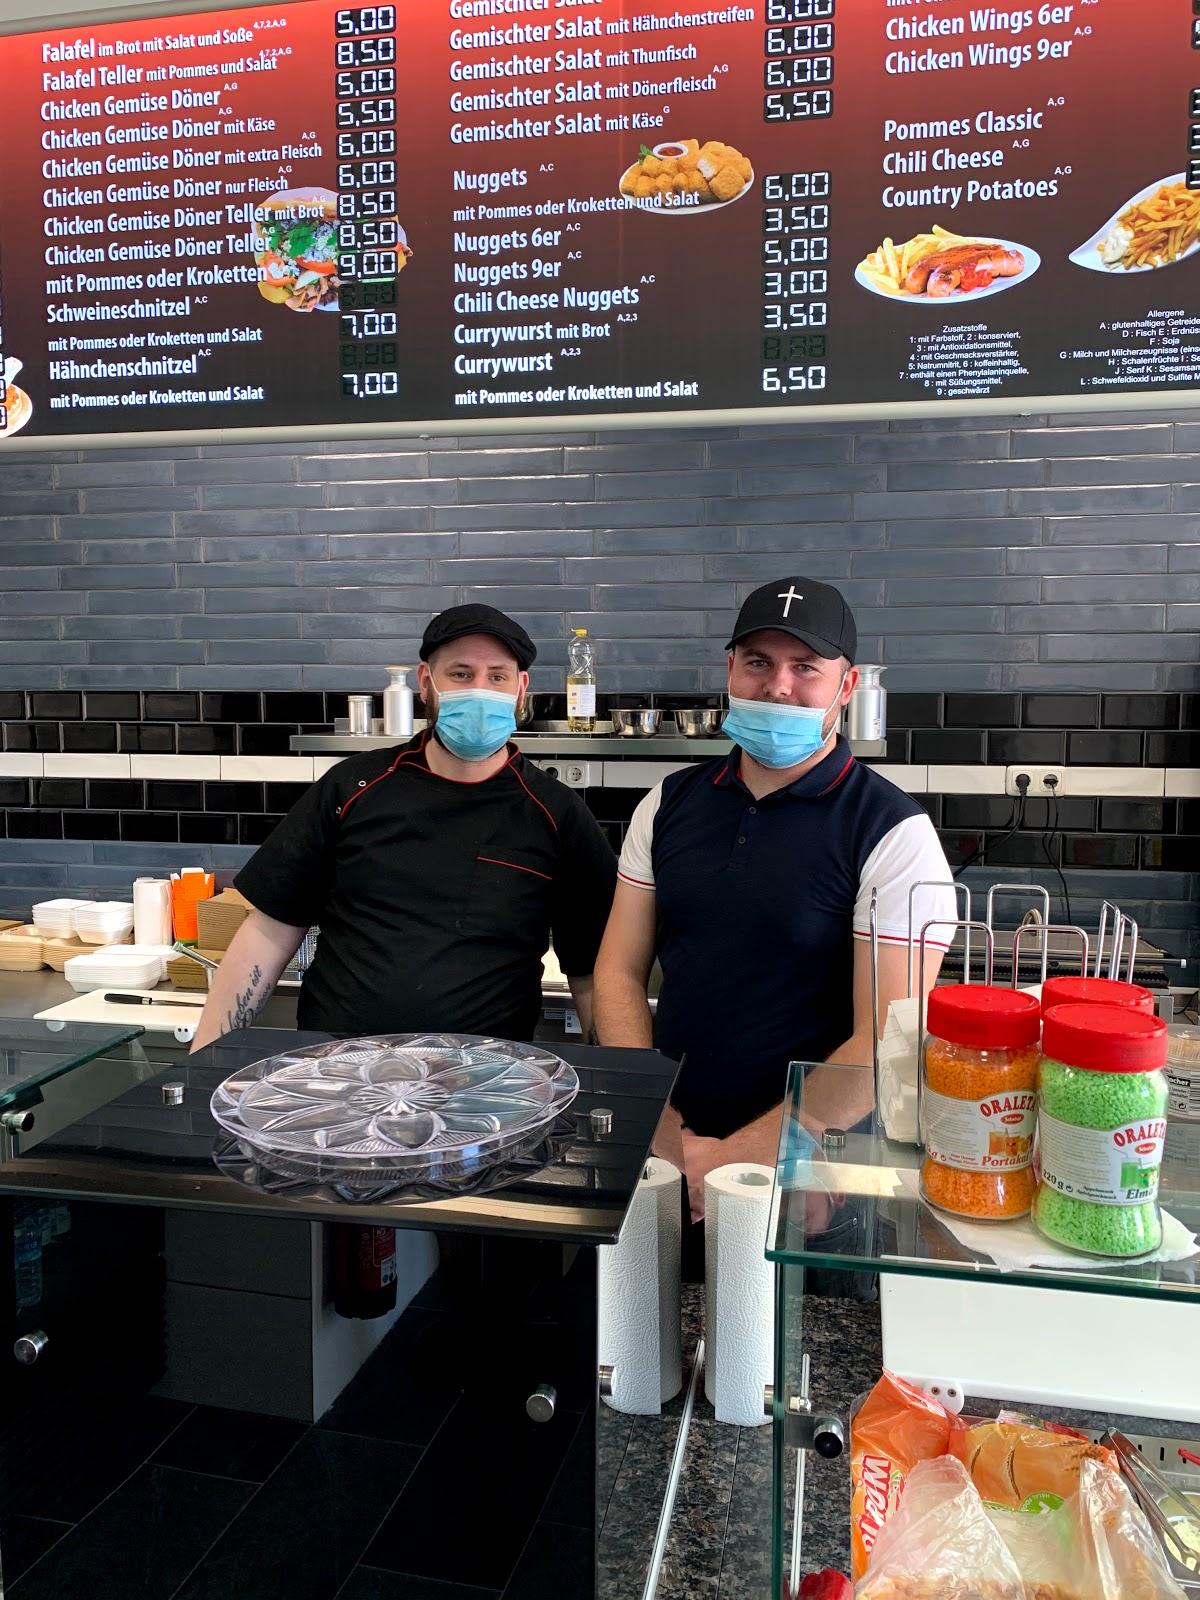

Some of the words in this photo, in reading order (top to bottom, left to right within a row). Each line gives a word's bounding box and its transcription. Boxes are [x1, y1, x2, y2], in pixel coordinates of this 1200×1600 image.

[450, 22, 551, 50] Gemischter
[555, 16, 602, 39] Salat
[606, 19, 629, 35] mit
[632, 7, 754, 32] Hähnchenstreifen
[886, 14, 964, 40] Chicken
[969, 8, 1032, 34] Wings
[1038, 4, 1073, 25] 6er
[42, 39, 95, 63] Falafel
[99, 44, 113, 56] im
[116, 40, 140, 55] Brot
[143, 36, 163, 52] mit
[165, 33, 195, 50] Salat
[198, 30, 220, 46] und
[223, 28, 253, 44] Soße
[885, 49, 963, 74] Chicken
[968, 42, 1031, 68] Wings
[1037, 38, 1072, 59] 9er
[43, 67, 95, 91] Falafel
[99, 62, 143, 86] Teller
[146, 66, 166, 82] mit
[169, 61, 218, 79] Pommes
[221, 58, 243, 74] und
[246, 55, 277, 71] Salat
[41, 97, 100, 122] Chicken
[104, 90, 167, 115] Gemüse
[172, 87, 220, 110] Döner
[450, 85, 550, 113] Gemischter
[554, 80, 602, 101] Salat
[606, 84, 629, 99] mit
[632, 75, 716, 96] Dönerfleisch
[42, 127, 101, 151] Chicken
[105, 120, 167, 144] Gemüse
[172, 117, 221, 139] Döner
[224, 120, 245, 134] mit
[248, 117, 275, 132] Käse
[450, 116, 550, 144] Gemischter
[554, 112, 601, 135] Salat
[606, 116, 629, 131] mit
[632, 113, 663, 128] Käse
[884, 118, 970, 141] Pommes
[975, 107, 1043, 134] Classic
[42, 156, 101, 180] Chicken
[106, 150, 168, 174] Gemüse
[173, 147, 221, 169] Döner
[224, 150, 245, 165] mit
[248, 148, 279, 163] extra
[281, 143, 322, 160] Fleisch
[883, 151, 927, 174] Chili
[932, 148, 1003, 170] Cheese
[43, 186, 102, 209] Chicken
[106, 180, 169, 203] Gemüse
[174, 176, 222, 199] Döner
[225, 182, 246, 194] nur
[248, 177, 288, 192] Fleisch
[454, 168, 527, 194] Nuggets
[882, 185, 963, 209] Country
[967, 178, 1058, 202] Potatoes
[44, 214, 103, 238] Chicken
[107, 209, 170, 231] Gemüse
[174, 204, 223, 228] Döner
[225, 202, 271, 224] Teller
[275, 206, 296, 219] mit
[298, 203, 324, 217] Brot
[453, 207, 475, 221] mit
[478, 204, 532, 220] Pommes
[536, 202, 563, 216] oder
[567, 197, 633, 213] Kroketten
[637, 195, 662, 210] und
[665, 191, 699, 207] Salat
[454, 230, 527, 255] Nuggets
[531, 227, 561, 247] 6er
[46, 277, 73, 295] mit
[77, 272, 144, 293] Pommes
[147, 268, 183, 288] oder
[187, 263, 267, 286] Kroketten
[454, 260, 527, 286] Nuggets
[531, 259, 561, 279] 9er
[47, 296, 190, 323] Schweineschnitzel
[454, 291, 492, 314] Chili
[497, 288, 559, 311] Cheese
[563, 285, 639, 312] Nuggets
[1148, 310, 1184, 318] Allergene
[455, 321, 552, 347] Currywurst
[556, 325, 579, 339] mit
[583, 323, 610, 338] Brot
[943, 324, 987, 332] Zusatzstoffe
[1162, 338, 1179, 346] Soja
[49, 355, 197, 380] Hähnchenschnitzel
[455, 352, 553, 377] Currywurst
[1127, 366, 1144, 374] Senf
[50, 393, 70, 408] mit
[72, 392, 119, 408] Pommes
[121, 390, 147, 405] oder
[149, 388, 206, 404] Kroketten
[209, 388, 231, 401] und
[233, 386, 263, 400] Salat
[455, 390, 477, 405] mit
[480, 388, 533, 404] Pommes
[535, 386, 566, 402] oder
[568, 383, 633, 400] Kroketten
[636, 384, 661, 398] und
[664, 381, 698, 397] Salat
